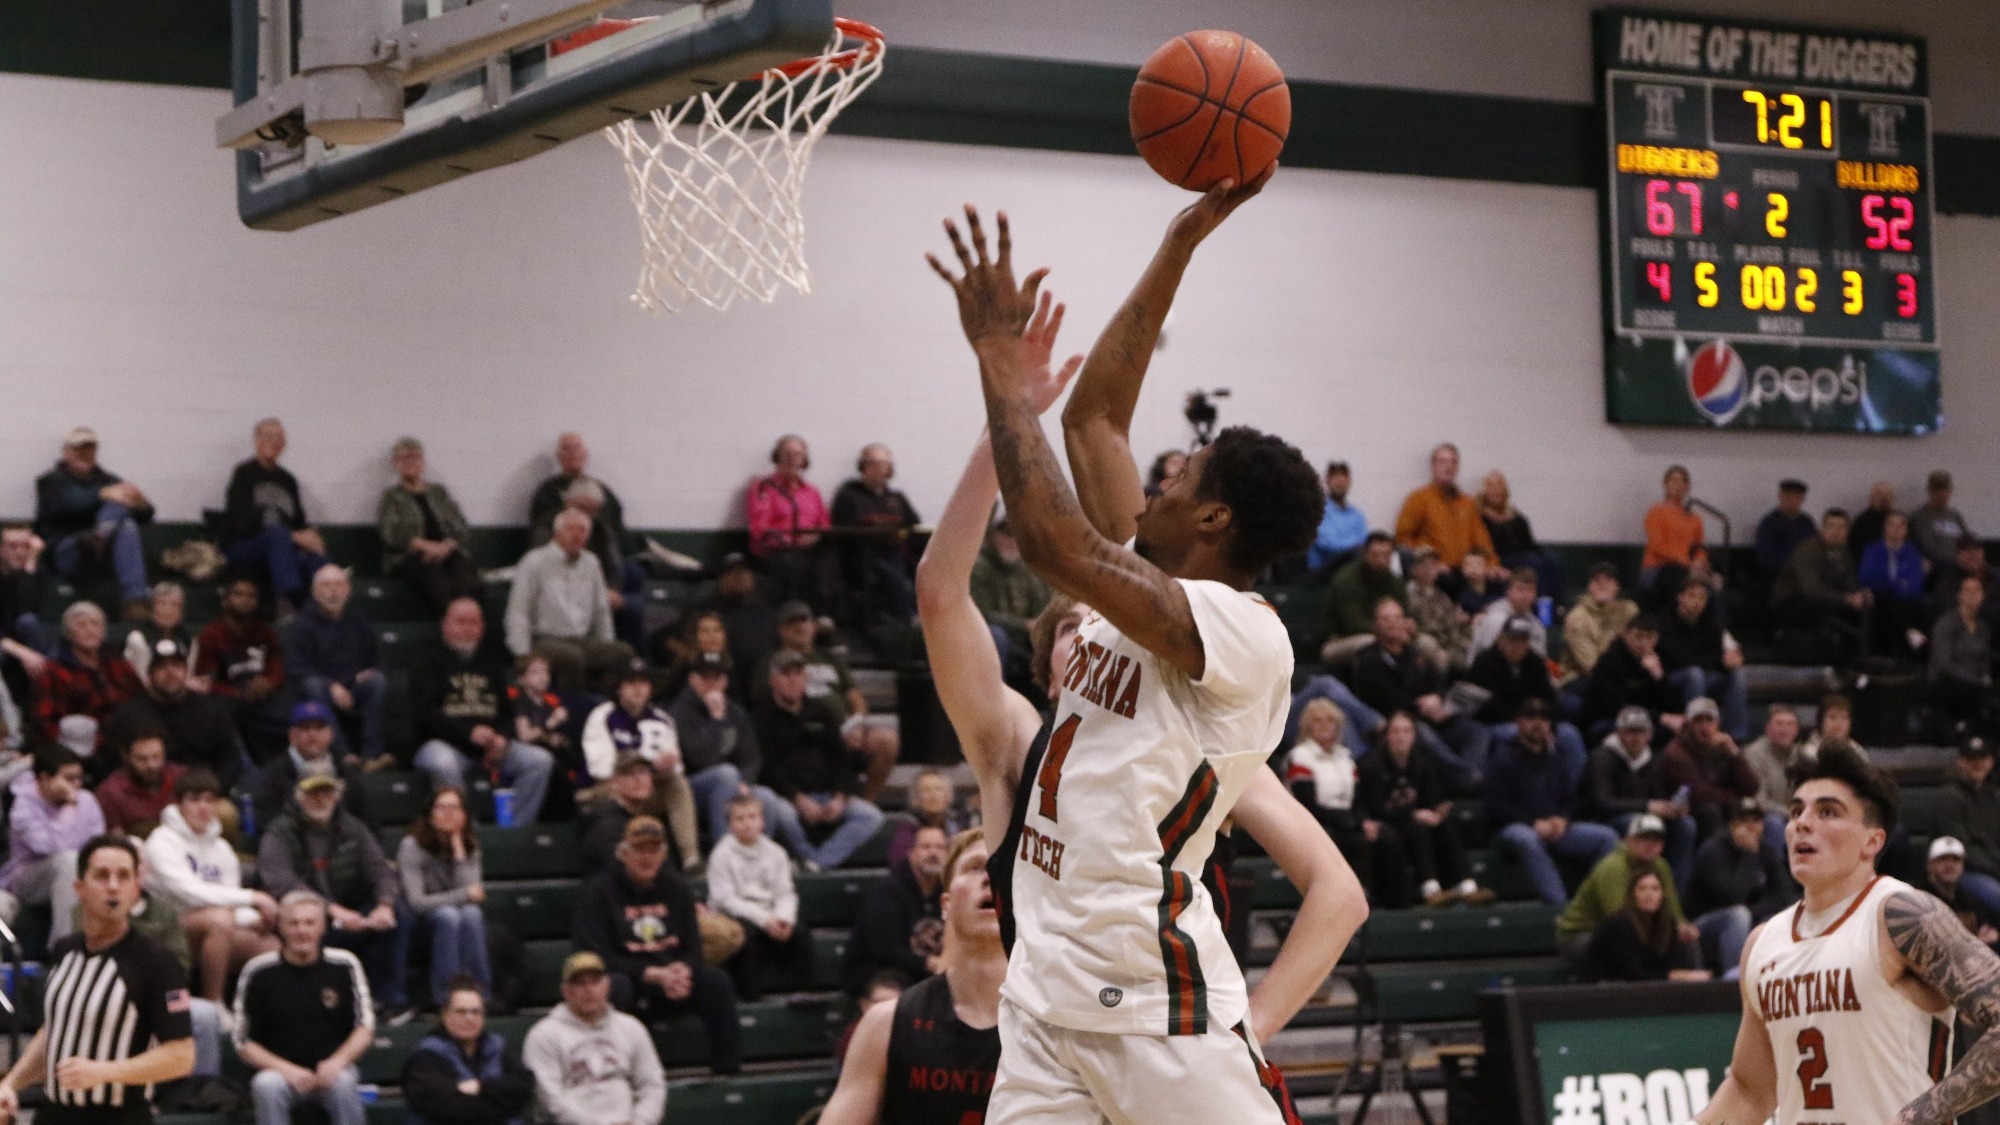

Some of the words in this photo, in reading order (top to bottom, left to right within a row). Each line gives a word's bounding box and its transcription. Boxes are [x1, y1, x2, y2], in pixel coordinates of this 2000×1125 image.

[1619, 16, 1703, 66] HOME
[1706, 26, 1746, 73] OF
[1750, 30, 1800, 77] THE
[1803, 35, 1918, 89] DIGGERS
[1742, 89, 1833, 151] 7:21
[1616, 143, 1720, 180] DIGGERS
[1836, 160, 1920, 194] BULLDOGS
[1645, 179, 1703, 237] 67
[1765, 192, 1789, 239] 2
[1861, 194, 1915, 252] 52
[1630, 237, 1676, 259] FOULS
[1734, 244, 1785, 265] PLAYER
[1646, 261, 1672, 304] 4
[1694, 261, 1719, 309] 5
[1740, 264, 1787, 313] 00
[1794, 267, 1819, 314] 2
[1842, 270, 1864, 316] 3
[1896, 272, 1918, 319] 3
[1757, 315, 1805, 337] MATCH
[1752, 359, 1867, 412] pepsi
[1037, 711, 1083, 825] 4
[1019, 824, 1066, 882] TECH
[1757, 967, 1862, 1022] MONTANA
[1796, 1026, 1835, 1111] 2
